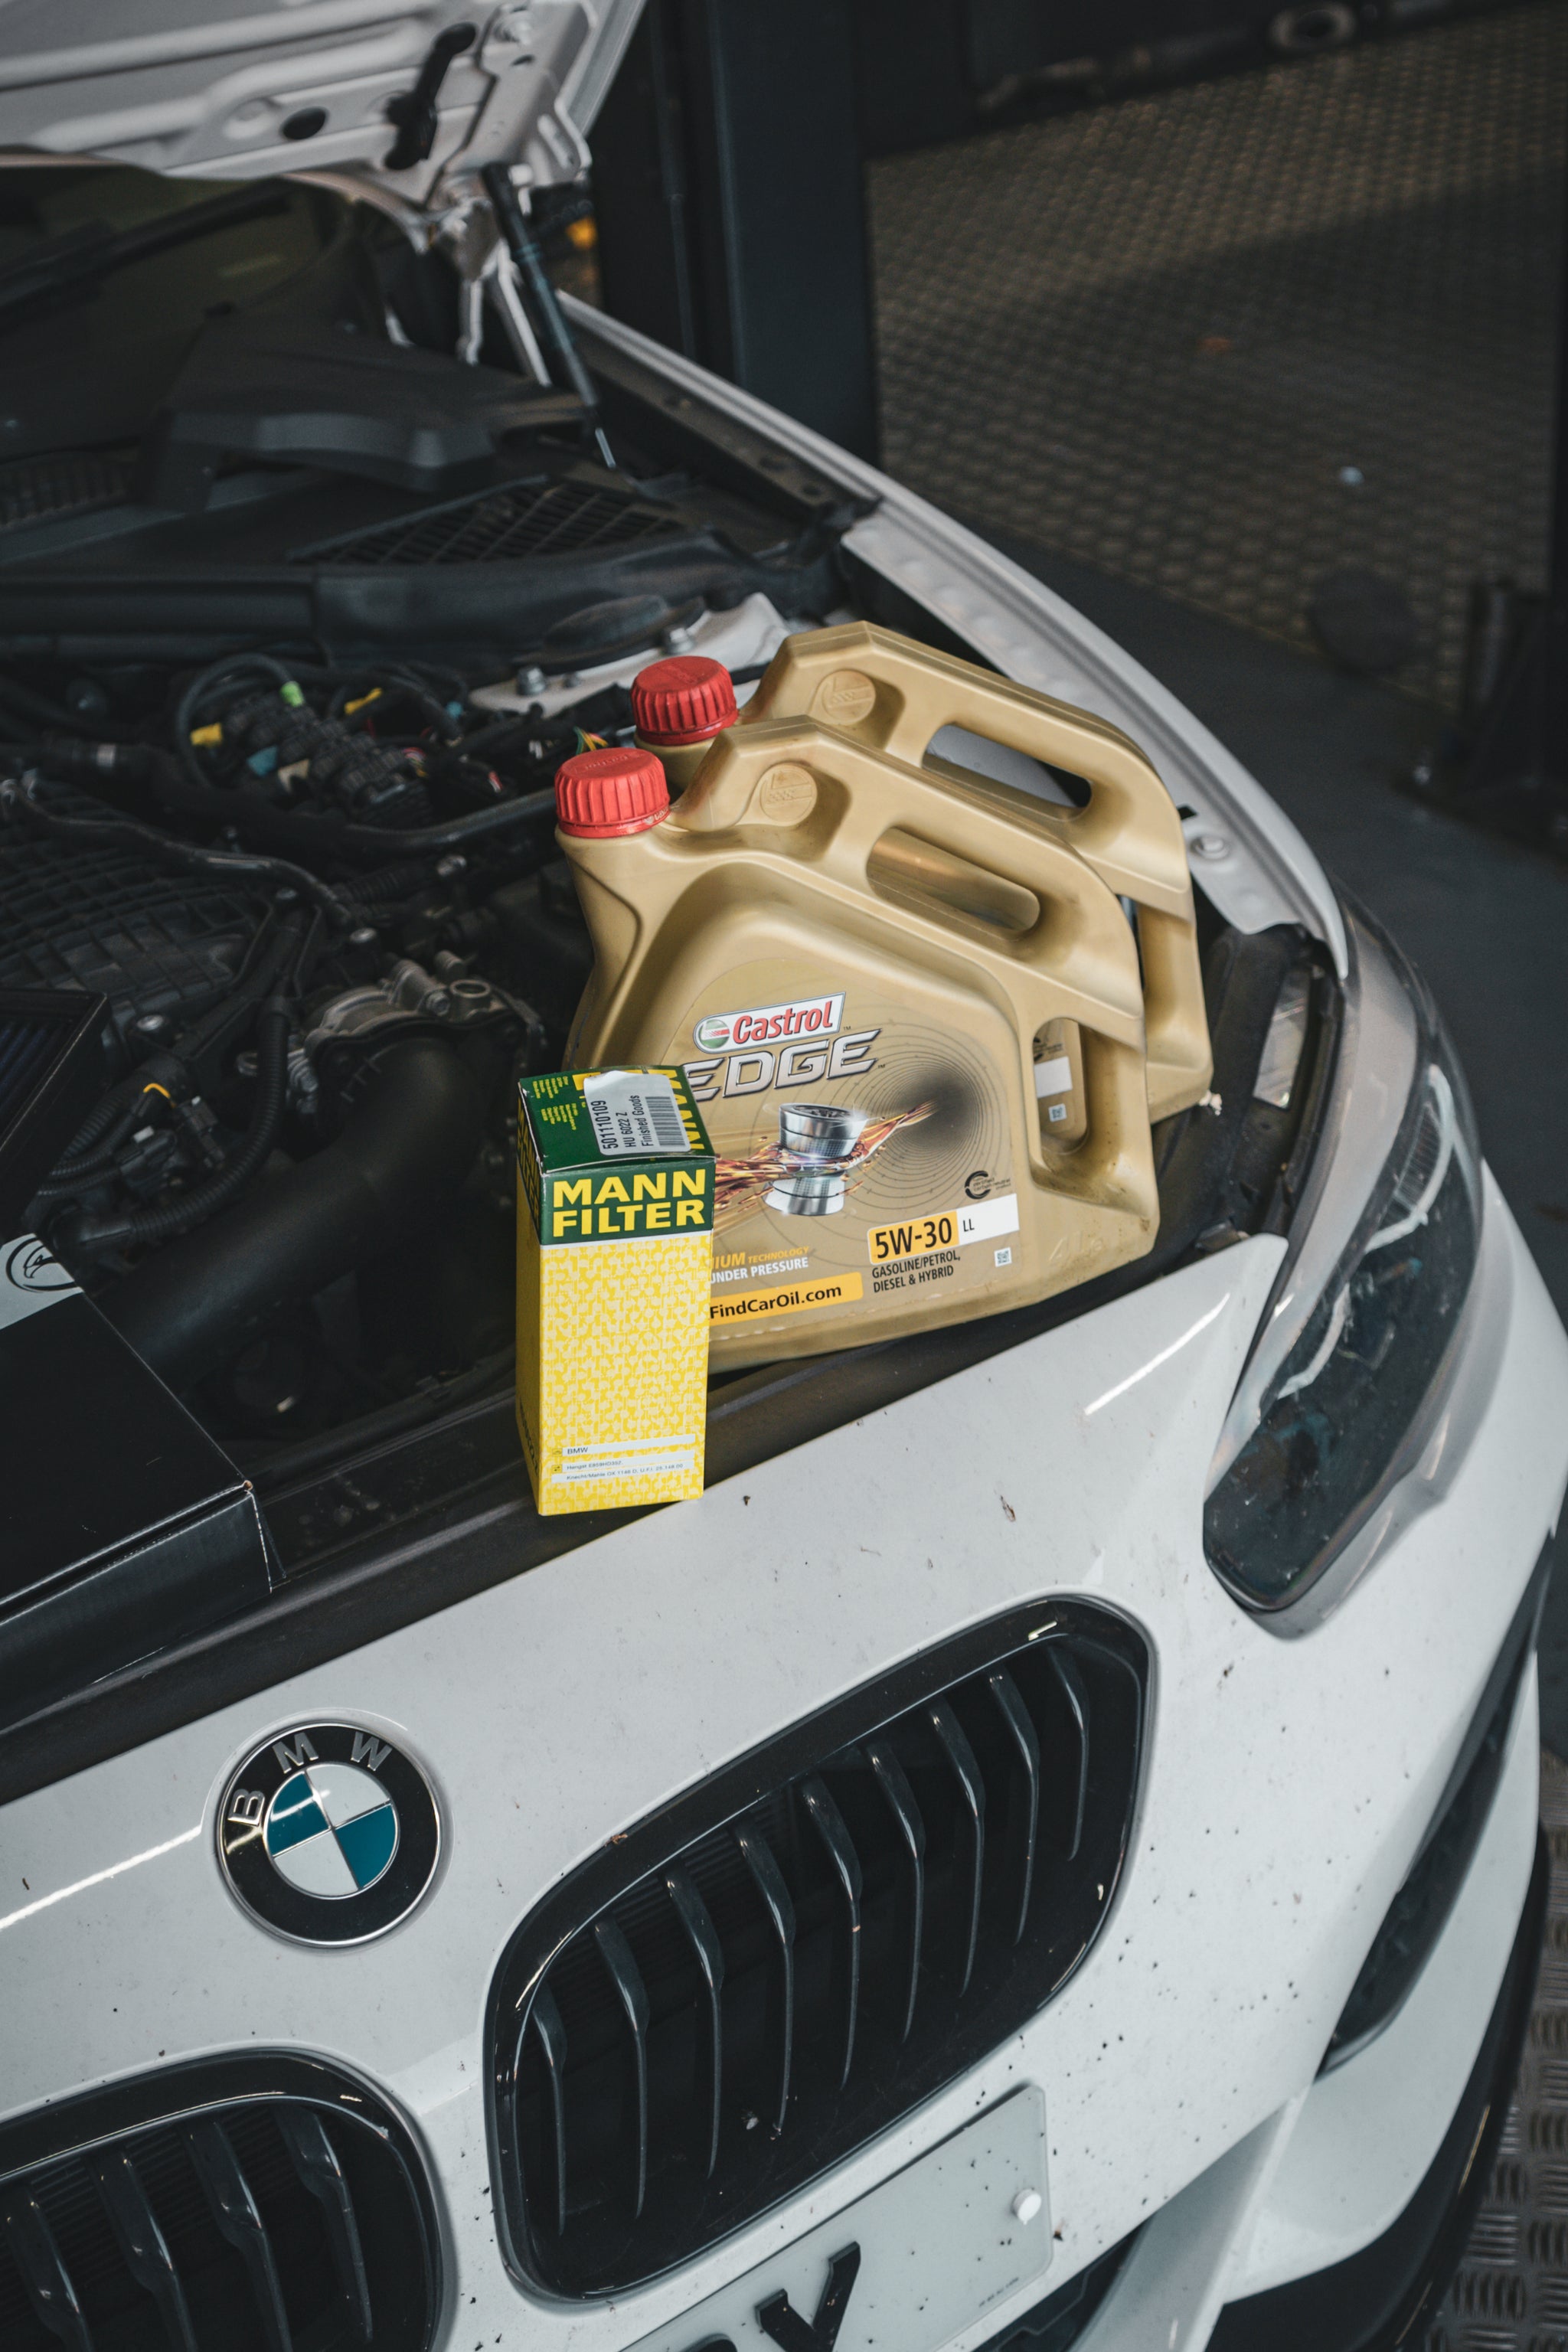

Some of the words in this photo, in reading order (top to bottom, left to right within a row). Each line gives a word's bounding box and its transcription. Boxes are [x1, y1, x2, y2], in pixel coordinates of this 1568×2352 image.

[733, 1000, 833, 1044] Castrol
[681, 1028, 883, 1103] EDGE
[629, 1095, 645, 1116] Goods
[618, 1119, 633, 1135] 6022
[635, 1117, 654, 1147] Finished
[622, 1137, 636, 1148] HU
[553, 1168, 706, 1208] MANN
[553, 1199, 705, 1237] FILTER
[875, 1217, 952, 1259] 5W-30
[963, 1218, 975, 1232] LL
[710, 1252, 746, 1270] IUM
[747, 1246, 809, 1263] TECHNOLOGY
[750, 1256, 809, 1278] PRESSURE
[872, 1250, 961, 1279] GASOLINE/PETROL,
[873, 1276, 906, 1293] DIESEL
[909, 1274, 916, 1285] &
[918, 1264, 954, 1284] HYBRID
[710, 1286, 842, 1319] FindCarOil.com
[567, 1446, 589, 1455] BMW
[227, 1731, 393, 1826] BMW
